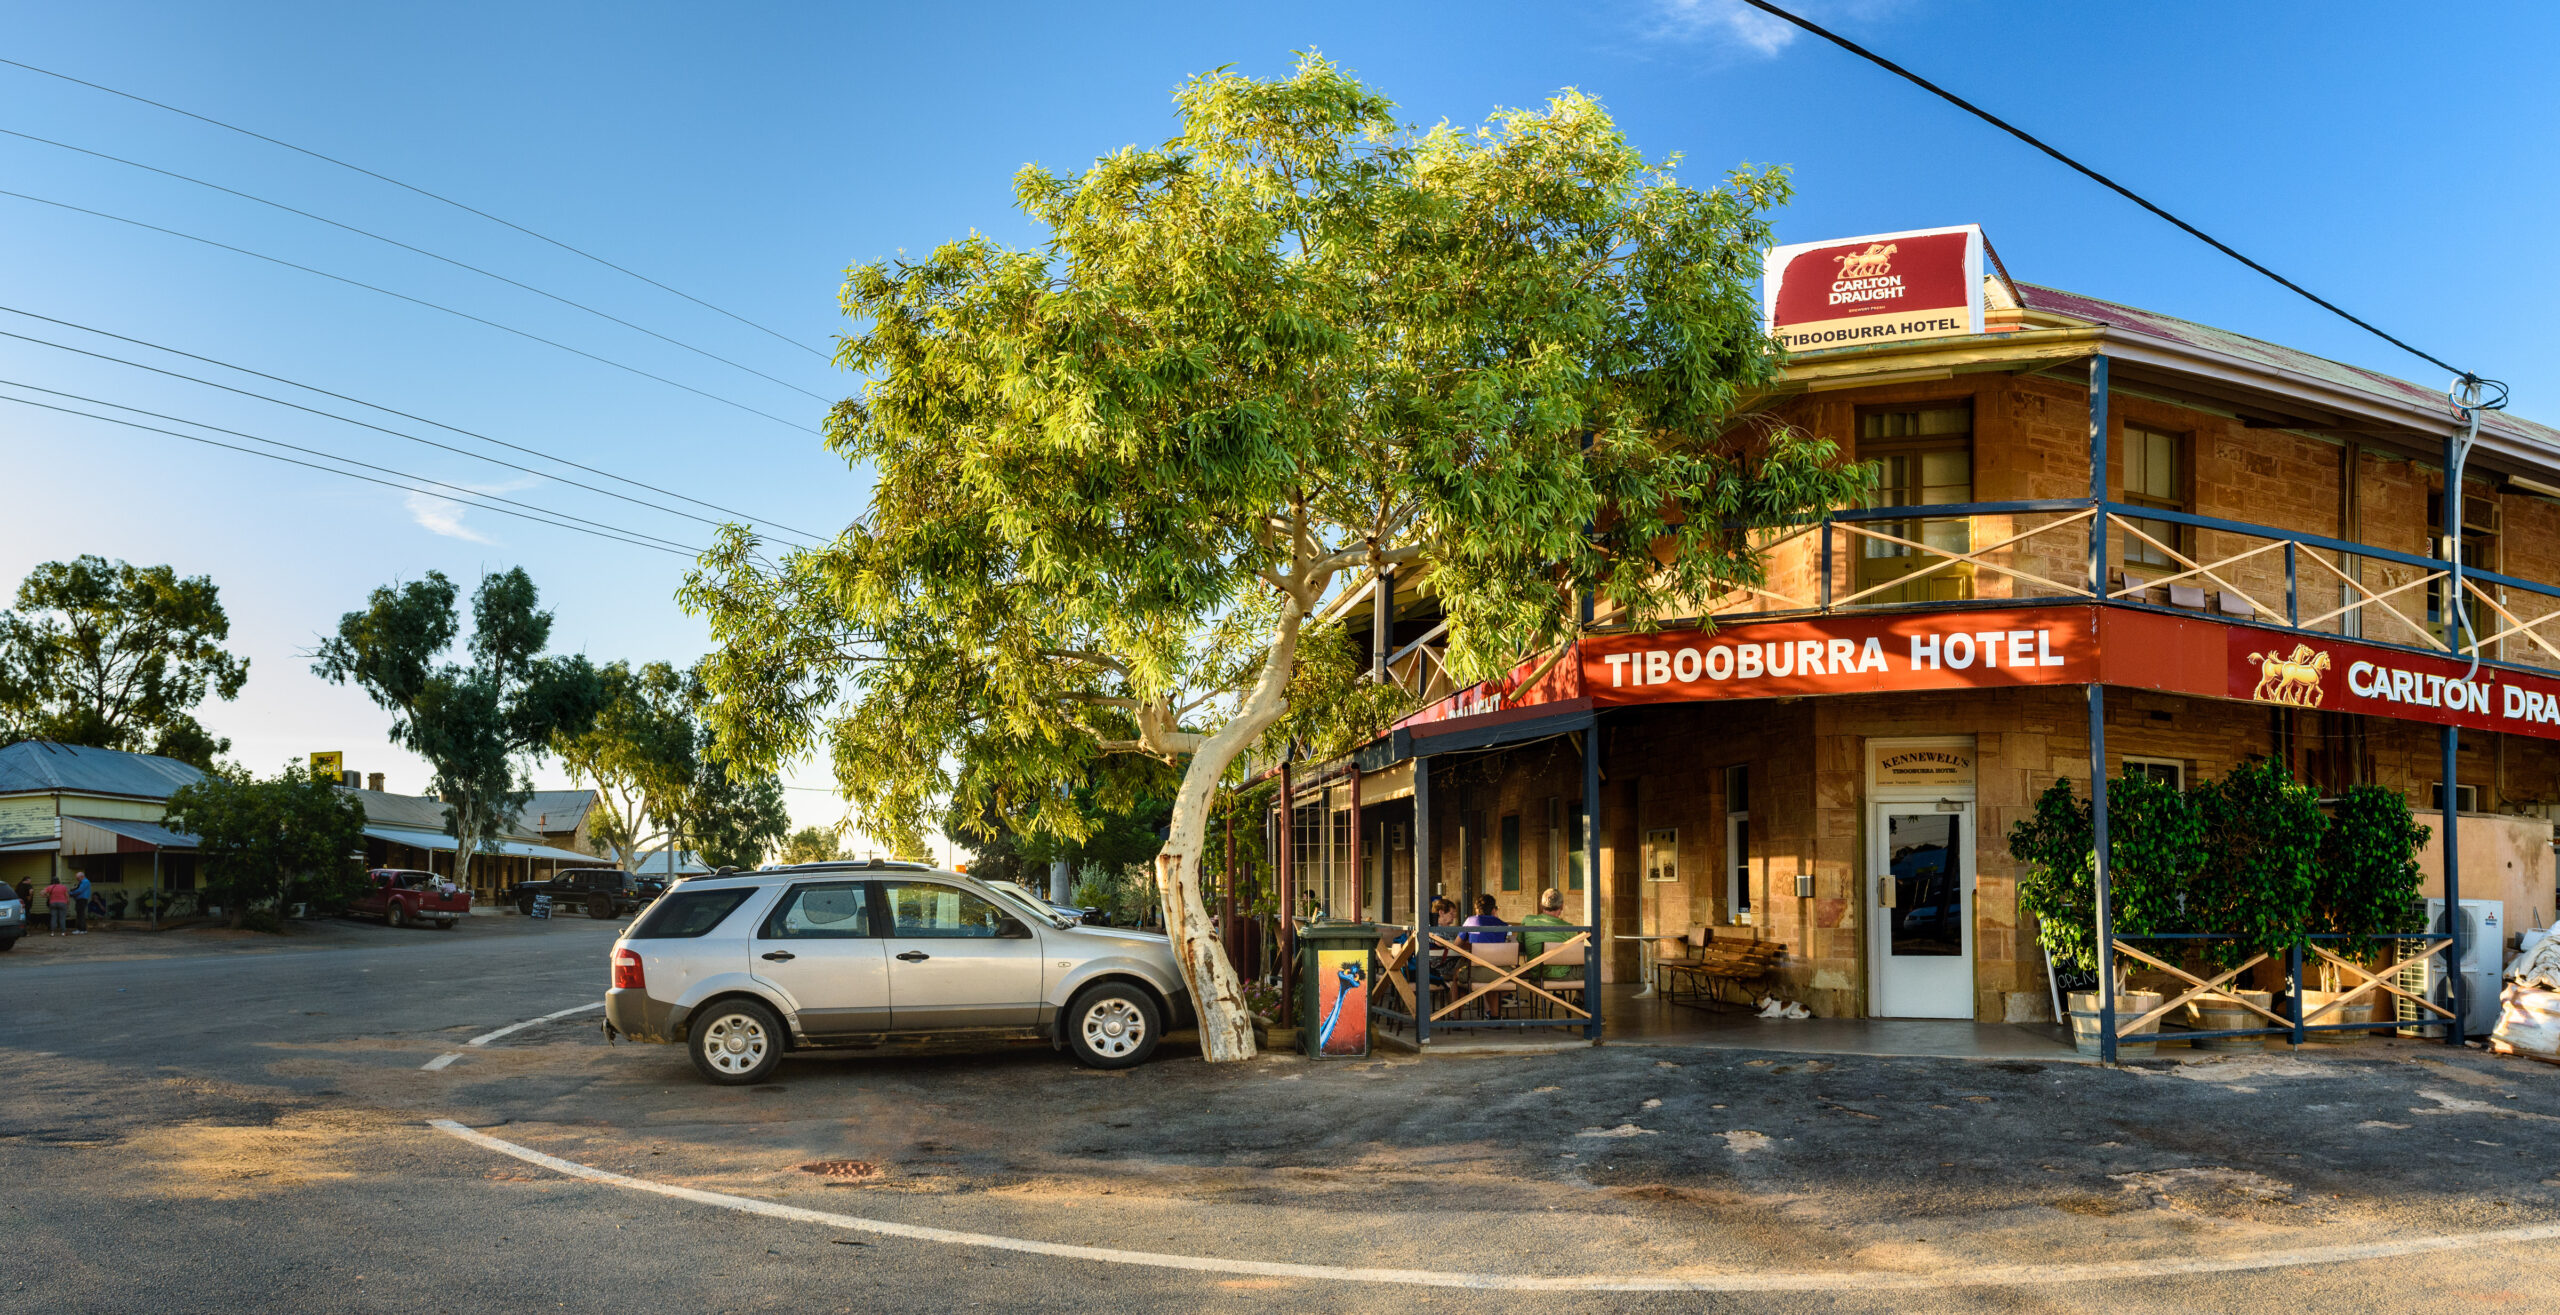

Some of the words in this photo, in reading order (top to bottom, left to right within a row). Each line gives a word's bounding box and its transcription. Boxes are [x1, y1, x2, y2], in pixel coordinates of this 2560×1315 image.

[1832, 275, 1902, 293] CARLTON
[1828, 286, 1906, 306] DRAUGHT
[1783, 323, 1897, 347] TIBOOBURRA
[1900, 318, 1961, 335] HOTEL
[1604, 636, 1889, 688] TIBOOBURRA
[1910, 630, 2065, 671] HOTEL
[2347, 660, 2491, 715] CARLTON
[1881, 752, 1970, 769] KENNEWELL'S
[2057, 970, 2096, 989] OPEN
